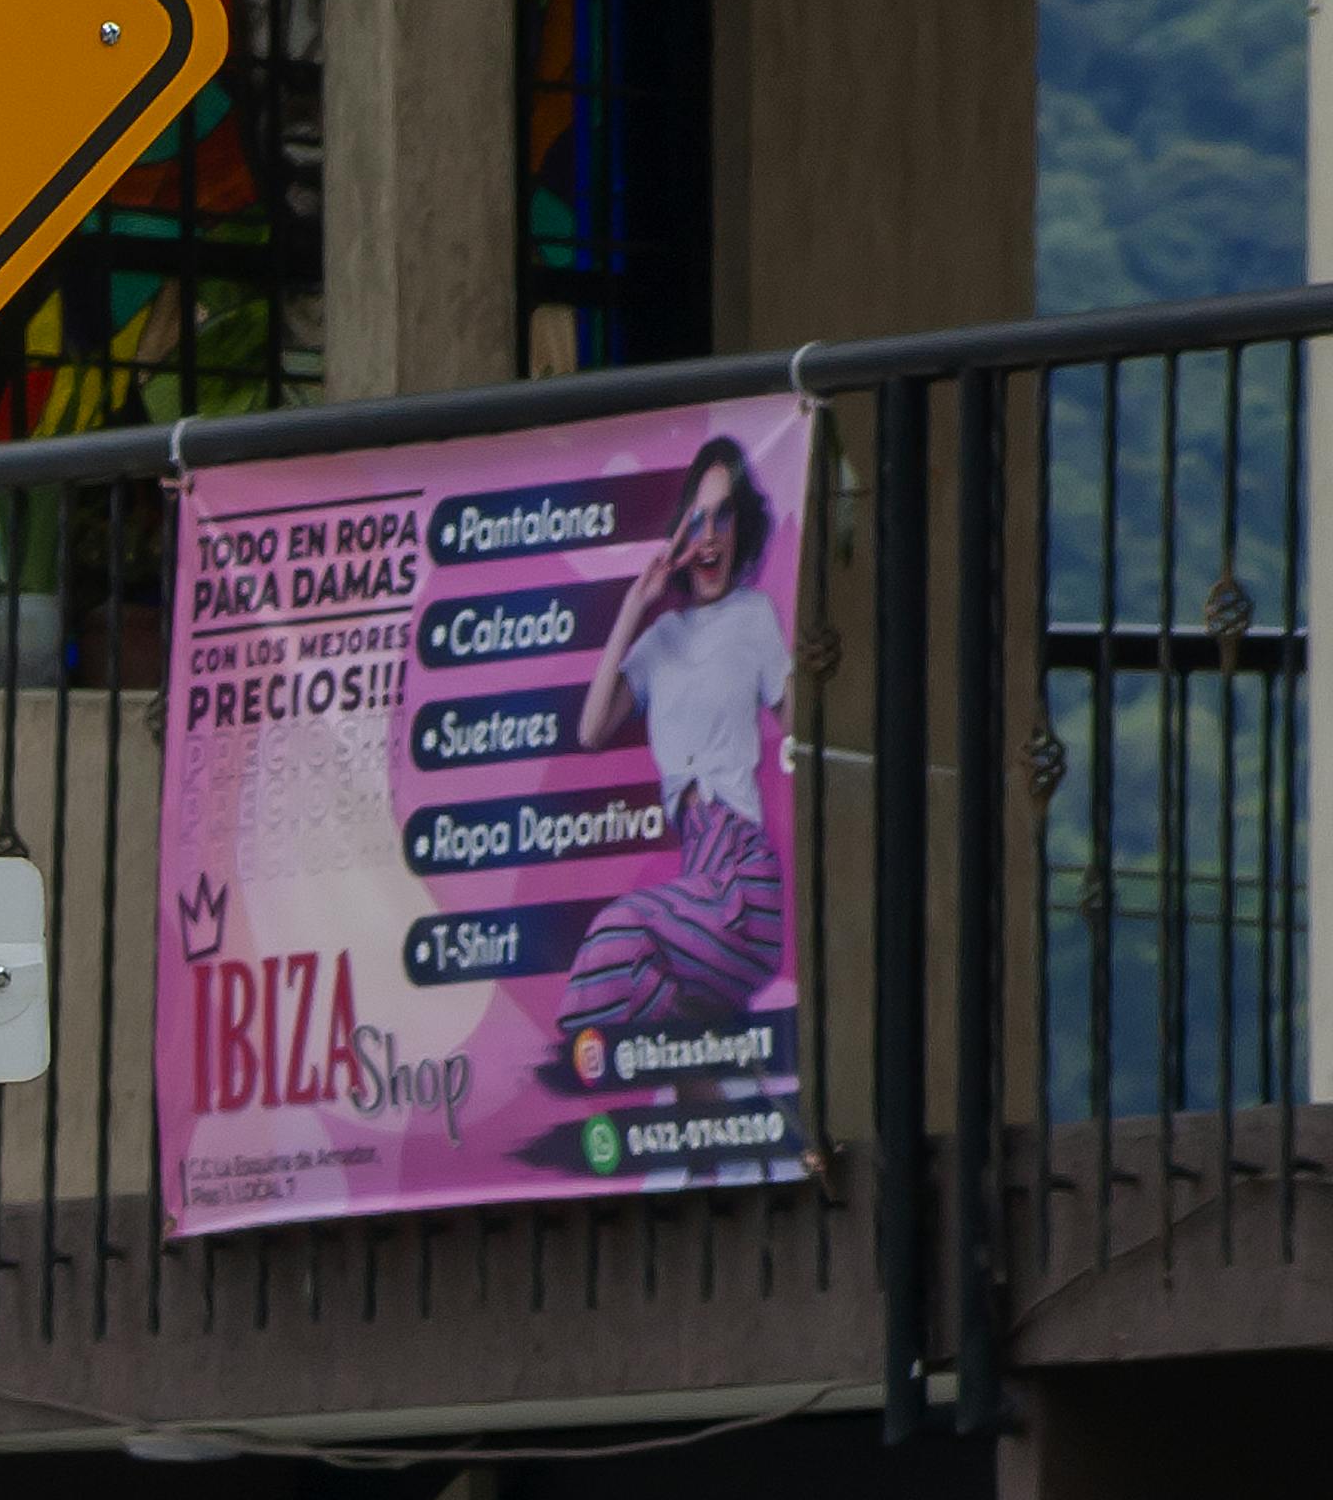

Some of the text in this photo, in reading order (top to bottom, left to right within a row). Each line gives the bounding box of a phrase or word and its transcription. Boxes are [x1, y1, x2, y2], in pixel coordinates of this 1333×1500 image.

[197, 510, 418, 571] TODO EN ROPA
[458, 498, 615, 553] Pantalones
[193, 553, 418, 622] PARA DAMAS
[191, 622, 411, 675] CON LOS MEJORES
[450, 598, 575, 656] Calzado
[187, 659, 408, 732] PRECIOS!!!
[440, 710, 558, 758] Sueteres
[433, 814, 511, 867] Ropa
[519, 800, 664, 856] Deportiva
[433, 921, 520, 971] T-Shirt
[192, 949, 471, 1148] IBIZA Shop
